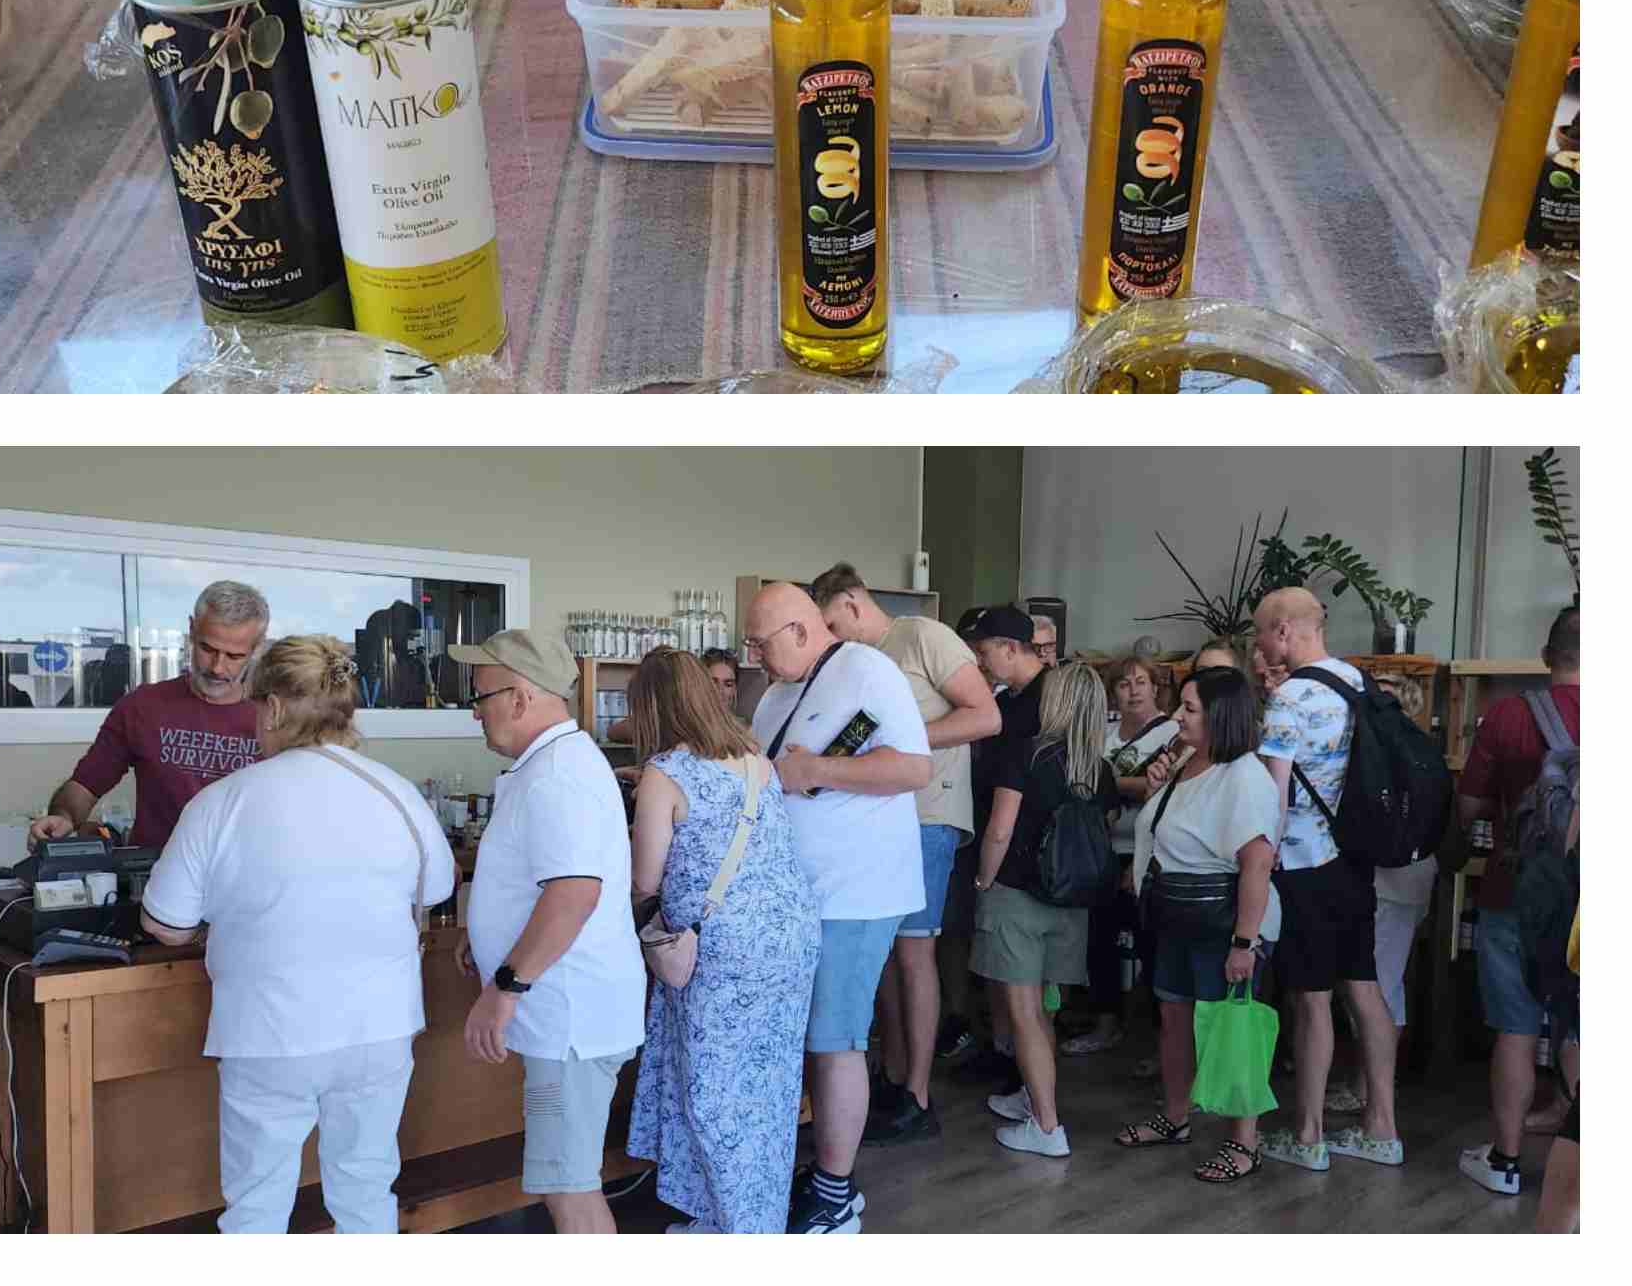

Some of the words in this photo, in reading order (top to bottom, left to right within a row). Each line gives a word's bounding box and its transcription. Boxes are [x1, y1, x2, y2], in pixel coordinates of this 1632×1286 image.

[148, 45, 182, 70] KOS
[1139, 83, 1192, 96] ORANGE
[816, 103, 859, 117] LEMON
[372, 184, 407, 195] Extra
[411, 173, 451, 191] Virgin
[383, 197, 418, 210] Olive
[423, 190, 444, 204] Oil
[194, 236, 284, 260] ΧΡΥΣΑΦΙ
[214, 276, 248, 291] Virgin
[251, 276, 282, 289] Olive
[285, 268, 303, 282] Oil
